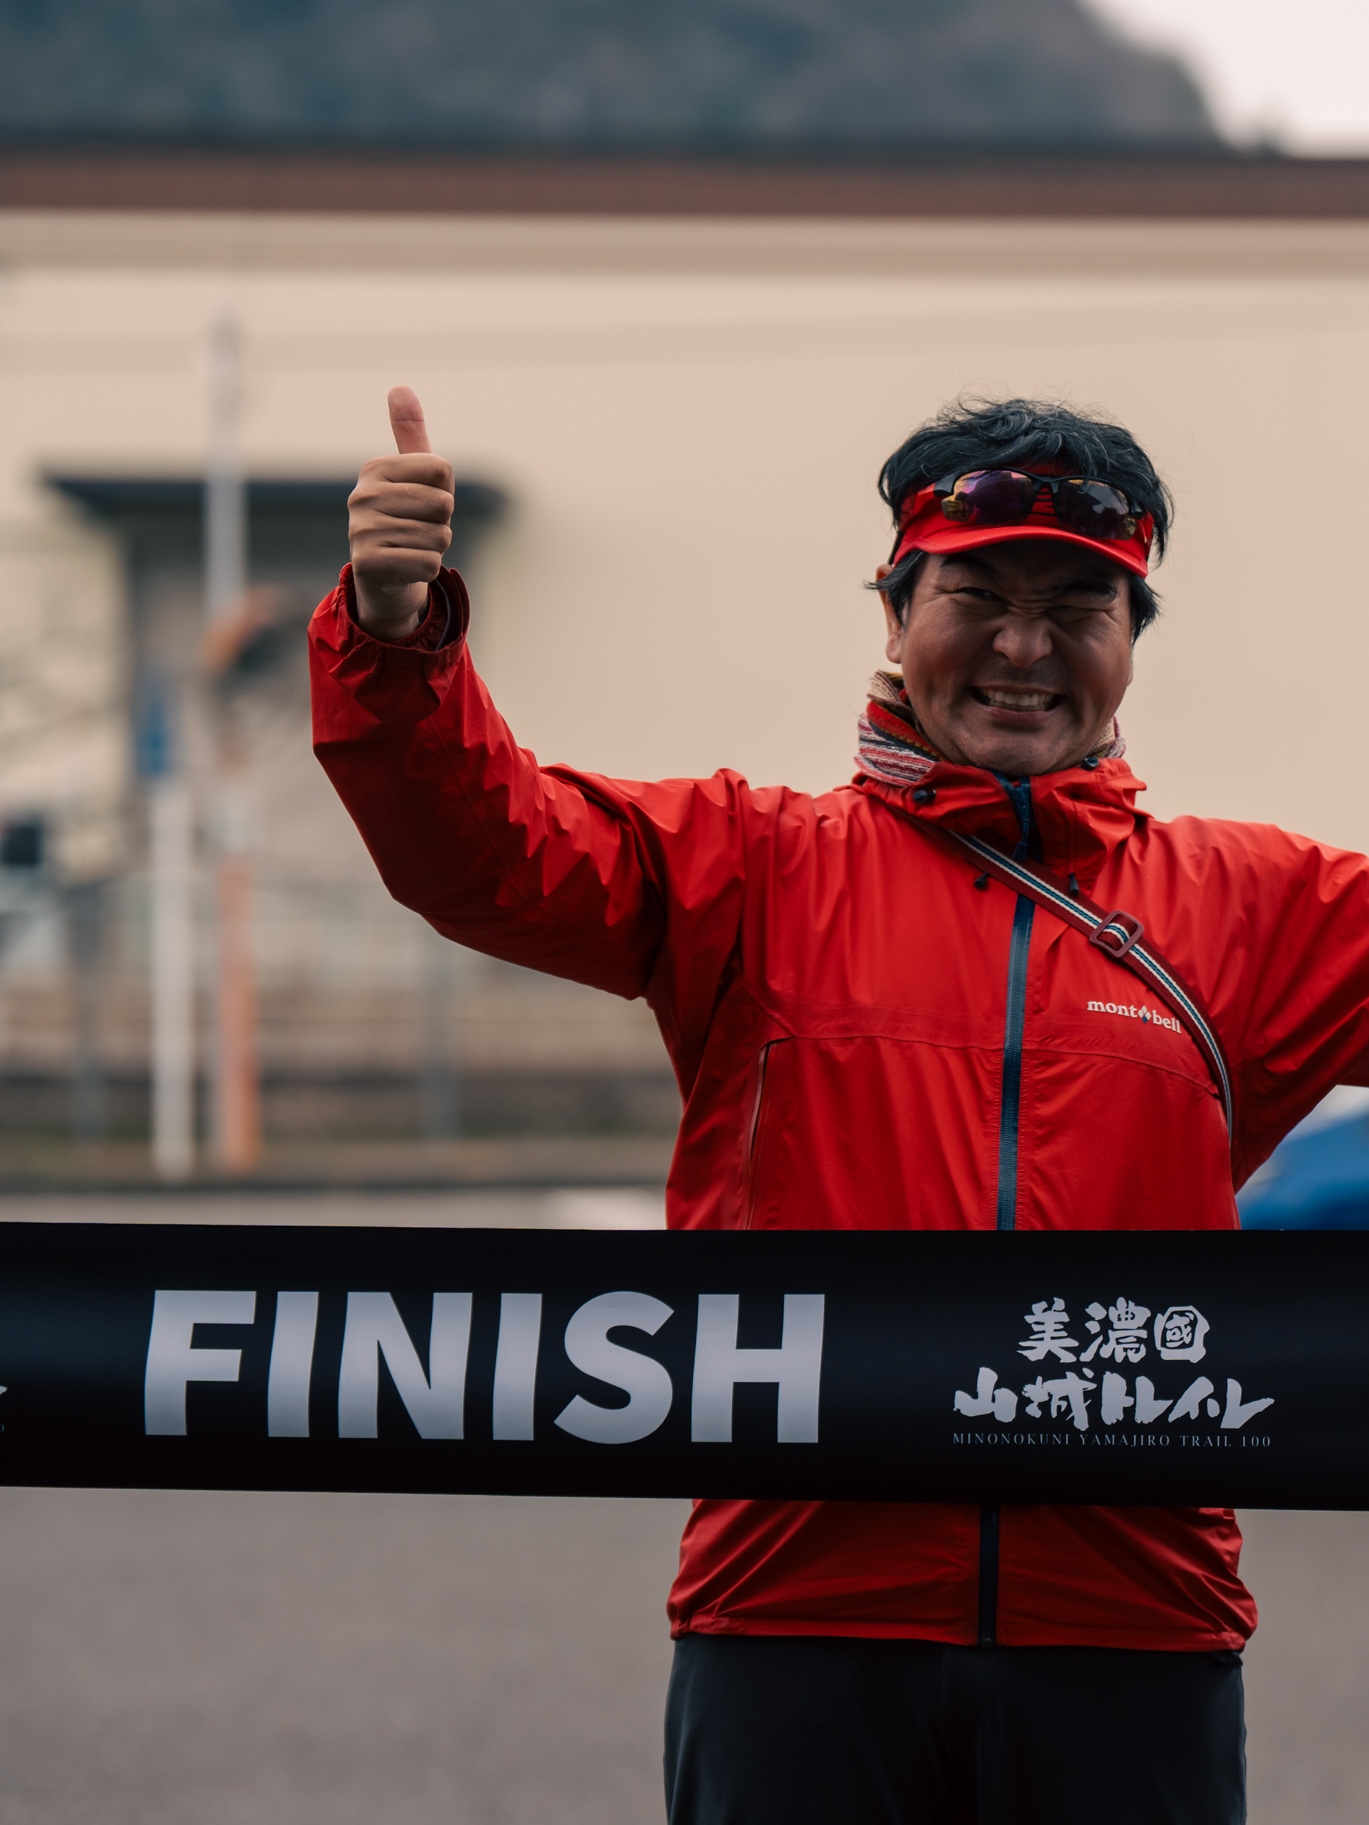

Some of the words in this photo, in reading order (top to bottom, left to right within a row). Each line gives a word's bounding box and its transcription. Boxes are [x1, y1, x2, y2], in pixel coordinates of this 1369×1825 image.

[144, 1289, 826, 1445] FINISH
[952, 1432, 1070, 1446] MINONOKUNI
[1079, 1434, 1171, 1448] YAMAJIRO
[1179, 1434, 1233, 1448] TRAIL
[1241, 1435, 1272, 1448] 100
